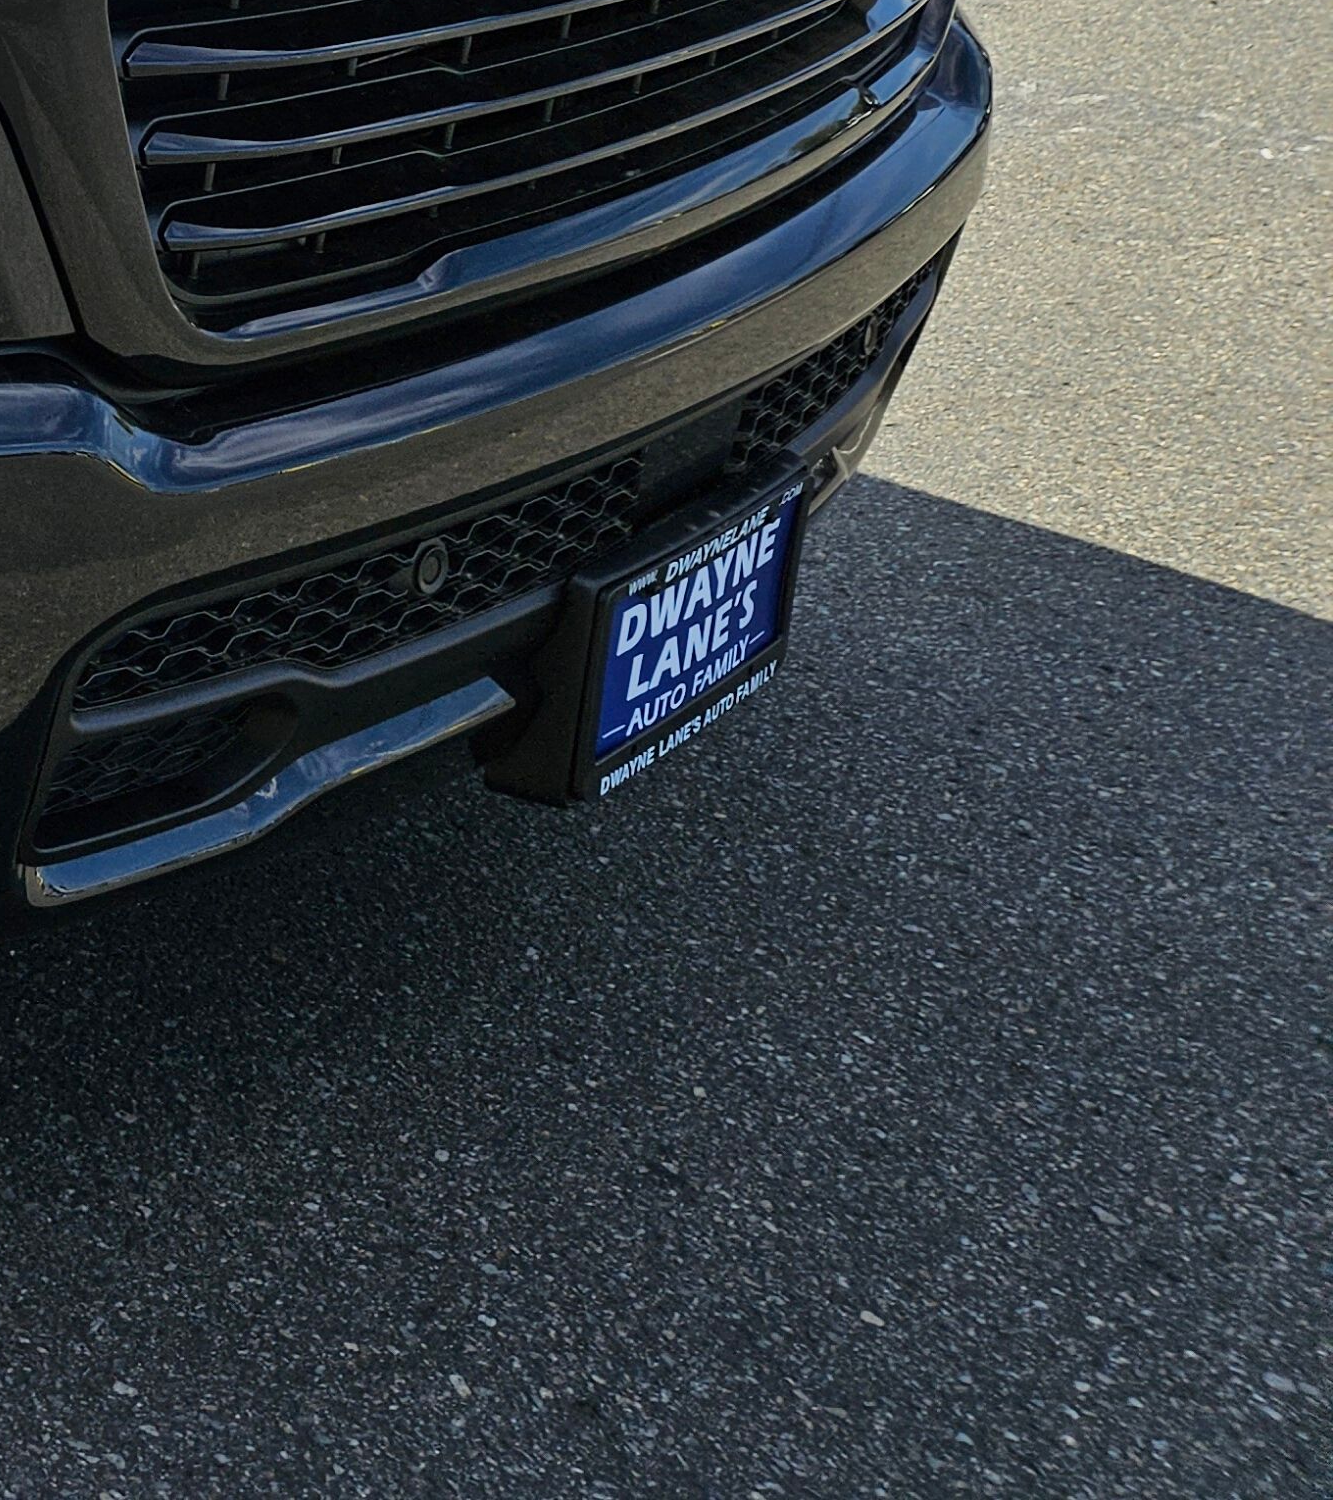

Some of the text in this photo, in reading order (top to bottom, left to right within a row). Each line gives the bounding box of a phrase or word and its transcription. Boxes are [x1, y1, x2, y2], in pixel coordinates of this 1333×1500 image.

[616, 517, 782, 656] DWAYNE
[626, 579, 758, 701] LANE'S
[599, 660, 779, 797] DWAYNE LANE'S AUTO FAMILY
[625, 633, 751, 738] AUTO FAMILY
